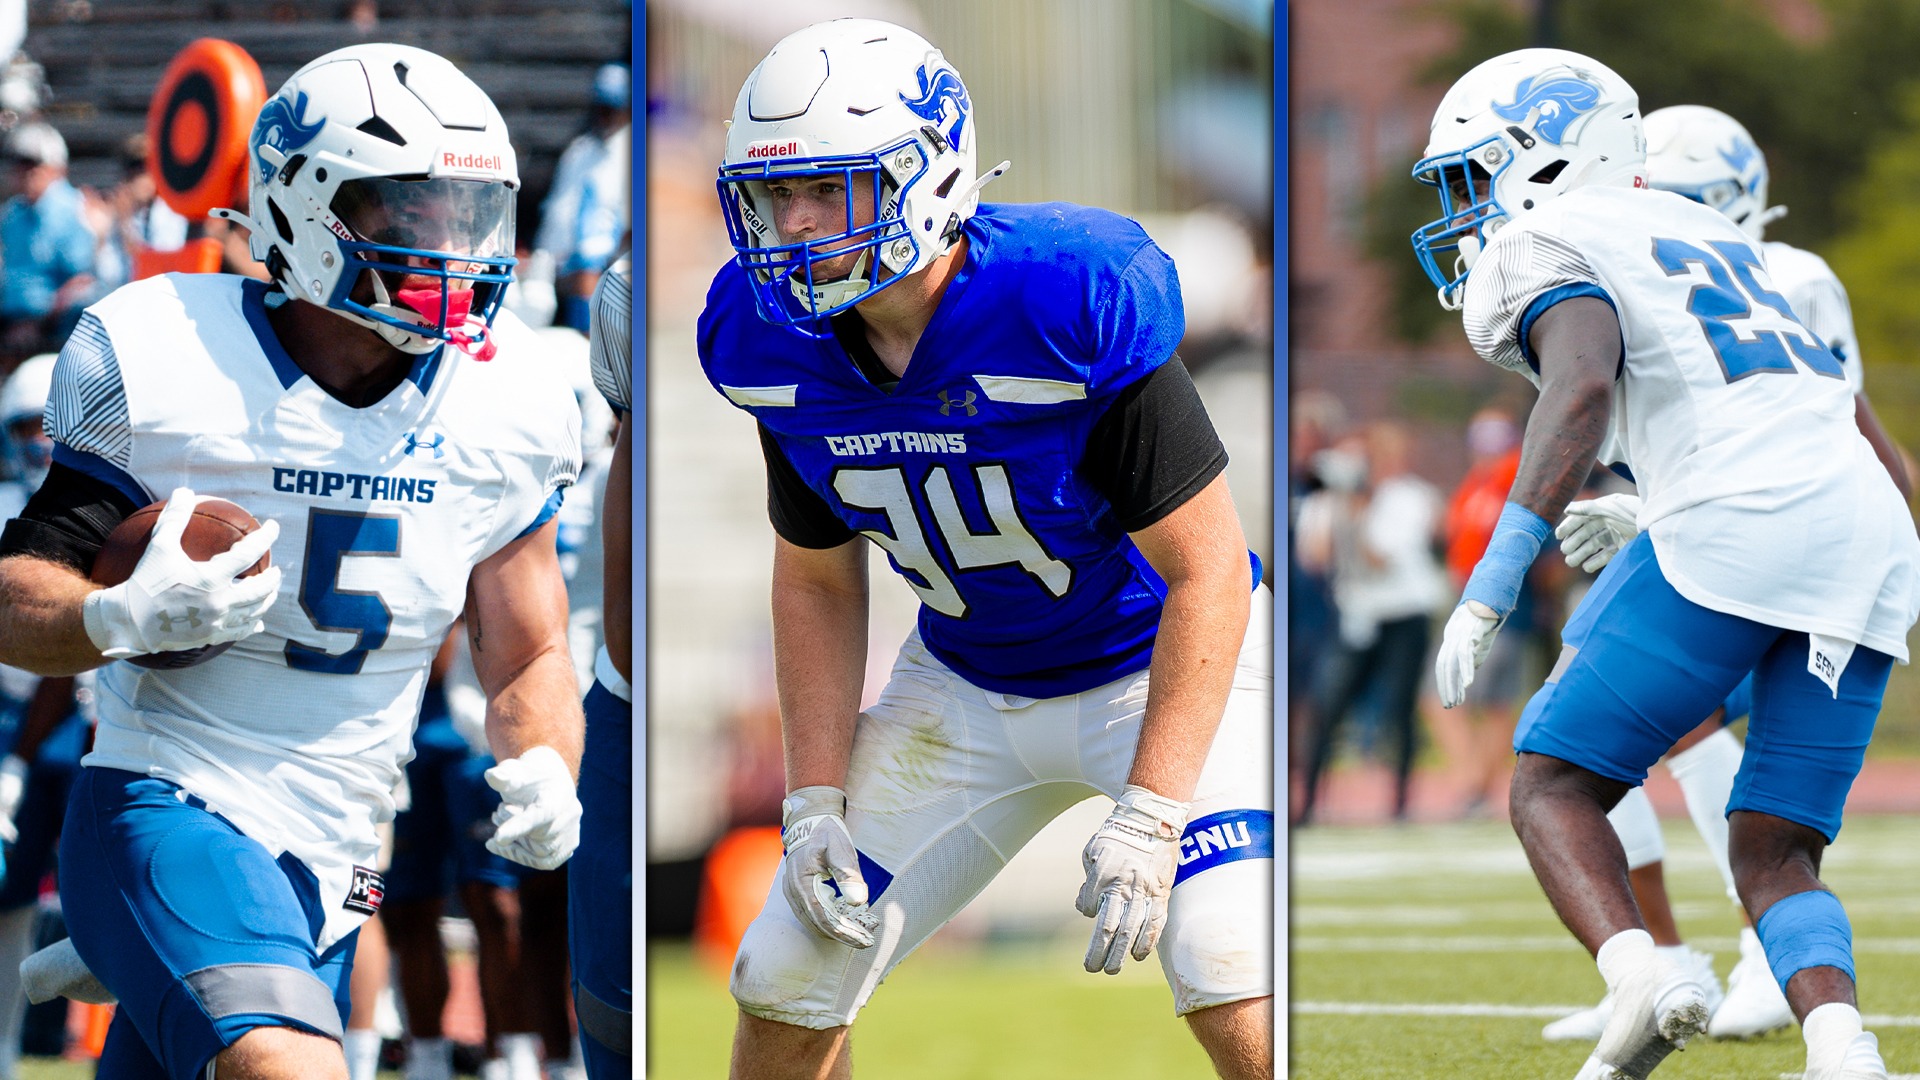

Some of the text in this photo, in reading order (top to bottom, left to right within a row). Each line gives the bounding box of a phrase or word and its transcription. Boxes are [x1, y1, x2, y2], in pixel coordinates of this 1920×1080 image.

[443, 153, 501, 170] Riddell
[748, 142, 796, 158] Riddell
[1651, 236, 1846, 384] 25
[824, 432, 967, 456] CAPTAINS
[272, 466, 437, 503] CAPTAINS
[830, 460, 1077, 620] 34
[284, 506, 402, 674] 5
[1178, 820, 1252, 866] CNU
